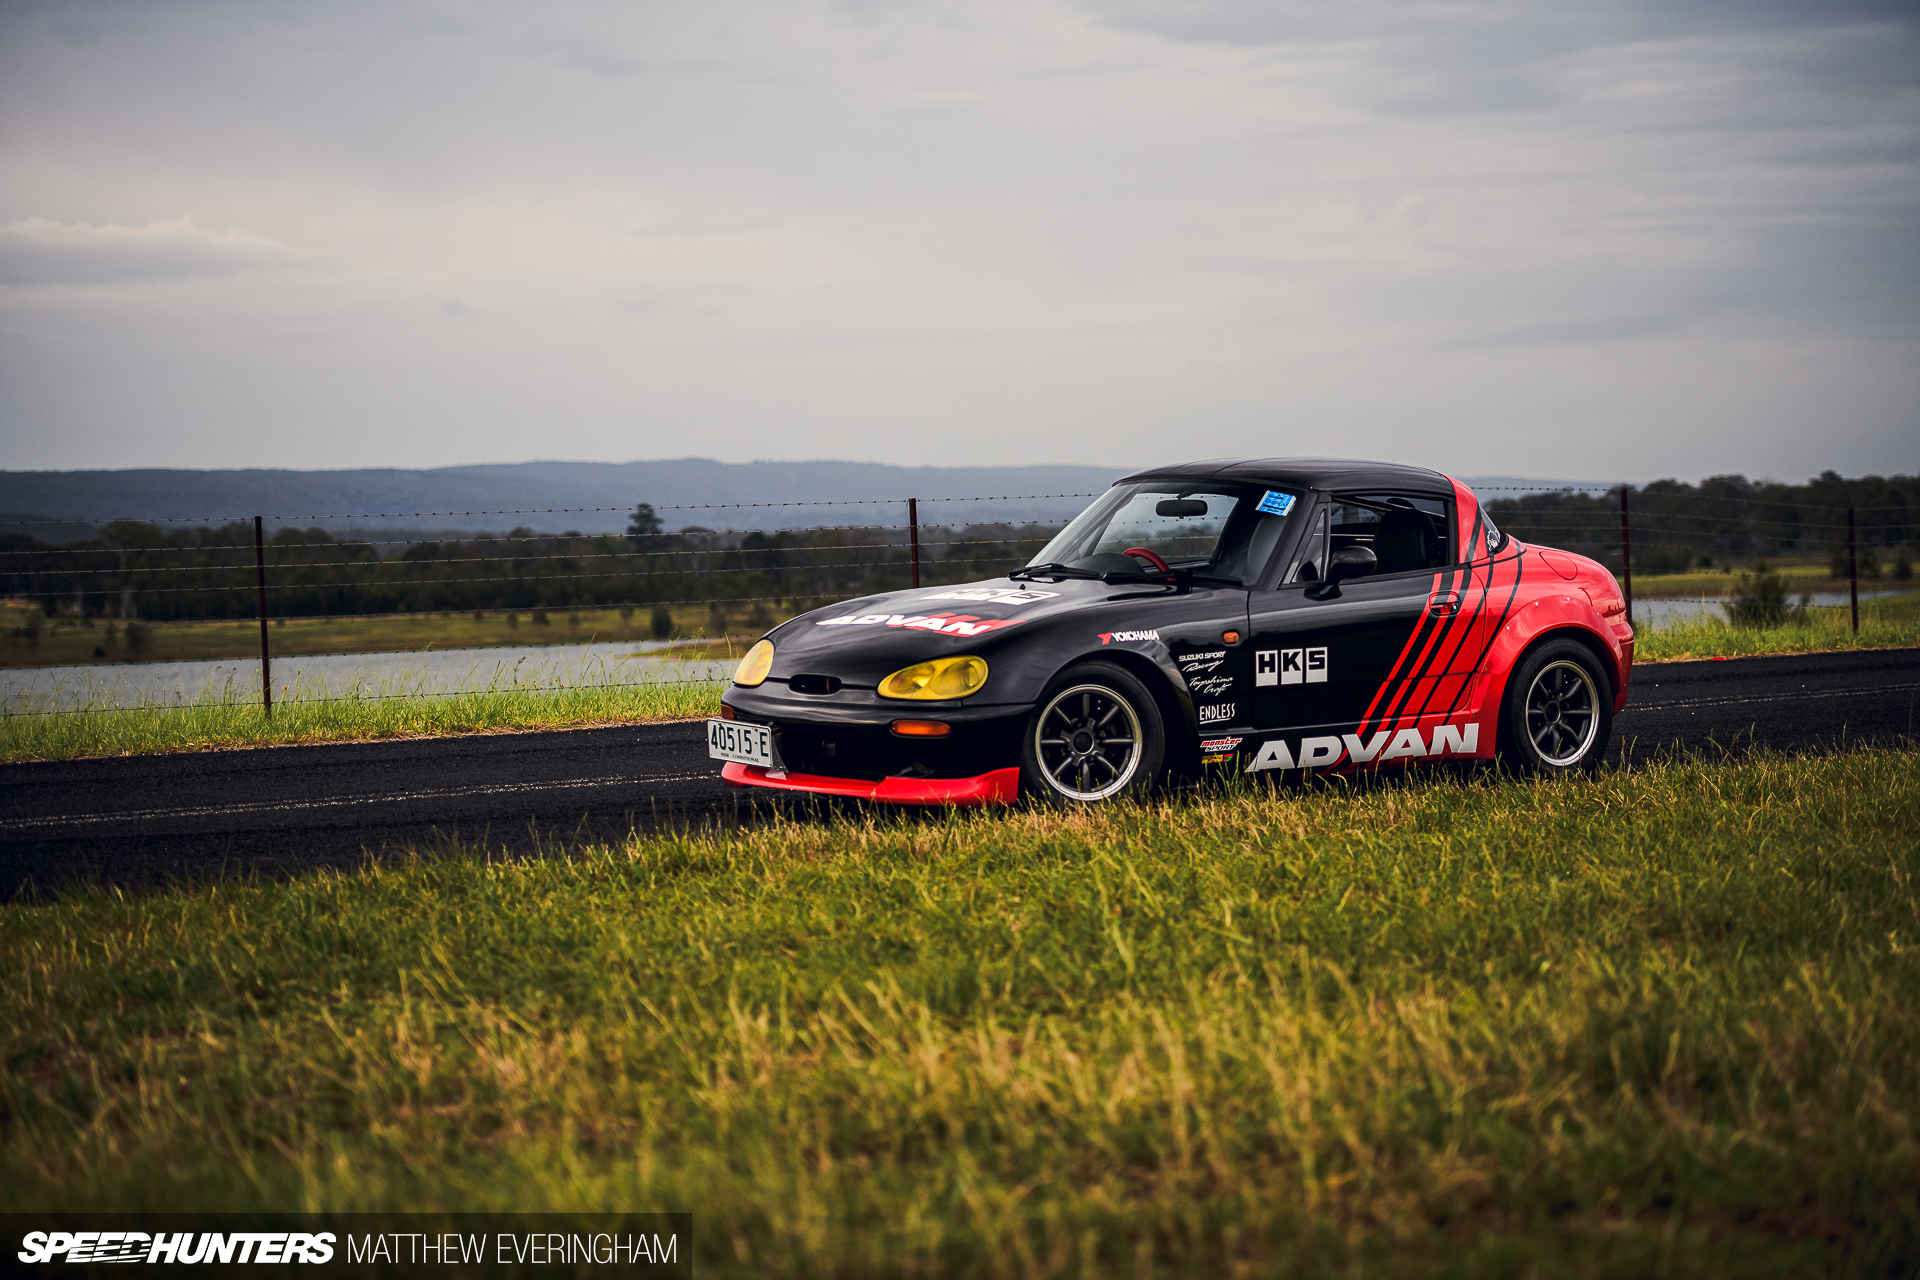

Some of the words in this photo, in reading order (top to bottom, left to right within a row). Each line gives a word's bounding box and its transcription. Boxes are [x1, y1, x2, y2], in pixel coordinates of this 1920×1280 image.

[816, 614, 991, 636] ADVAN
[1111, 630, 1160, 642] YOKOHAMA
[1179, 653, 1203, 661] SUZUKI
[1204, 651, 1226, 659] SPORT
[1182, 659, 1224, 672] Racing
[1256, 648, 1327, 677] HKS
[1199, 702, 1236, 721] ENDLESS
[1244, 722, 1480, 773] ADVAN
